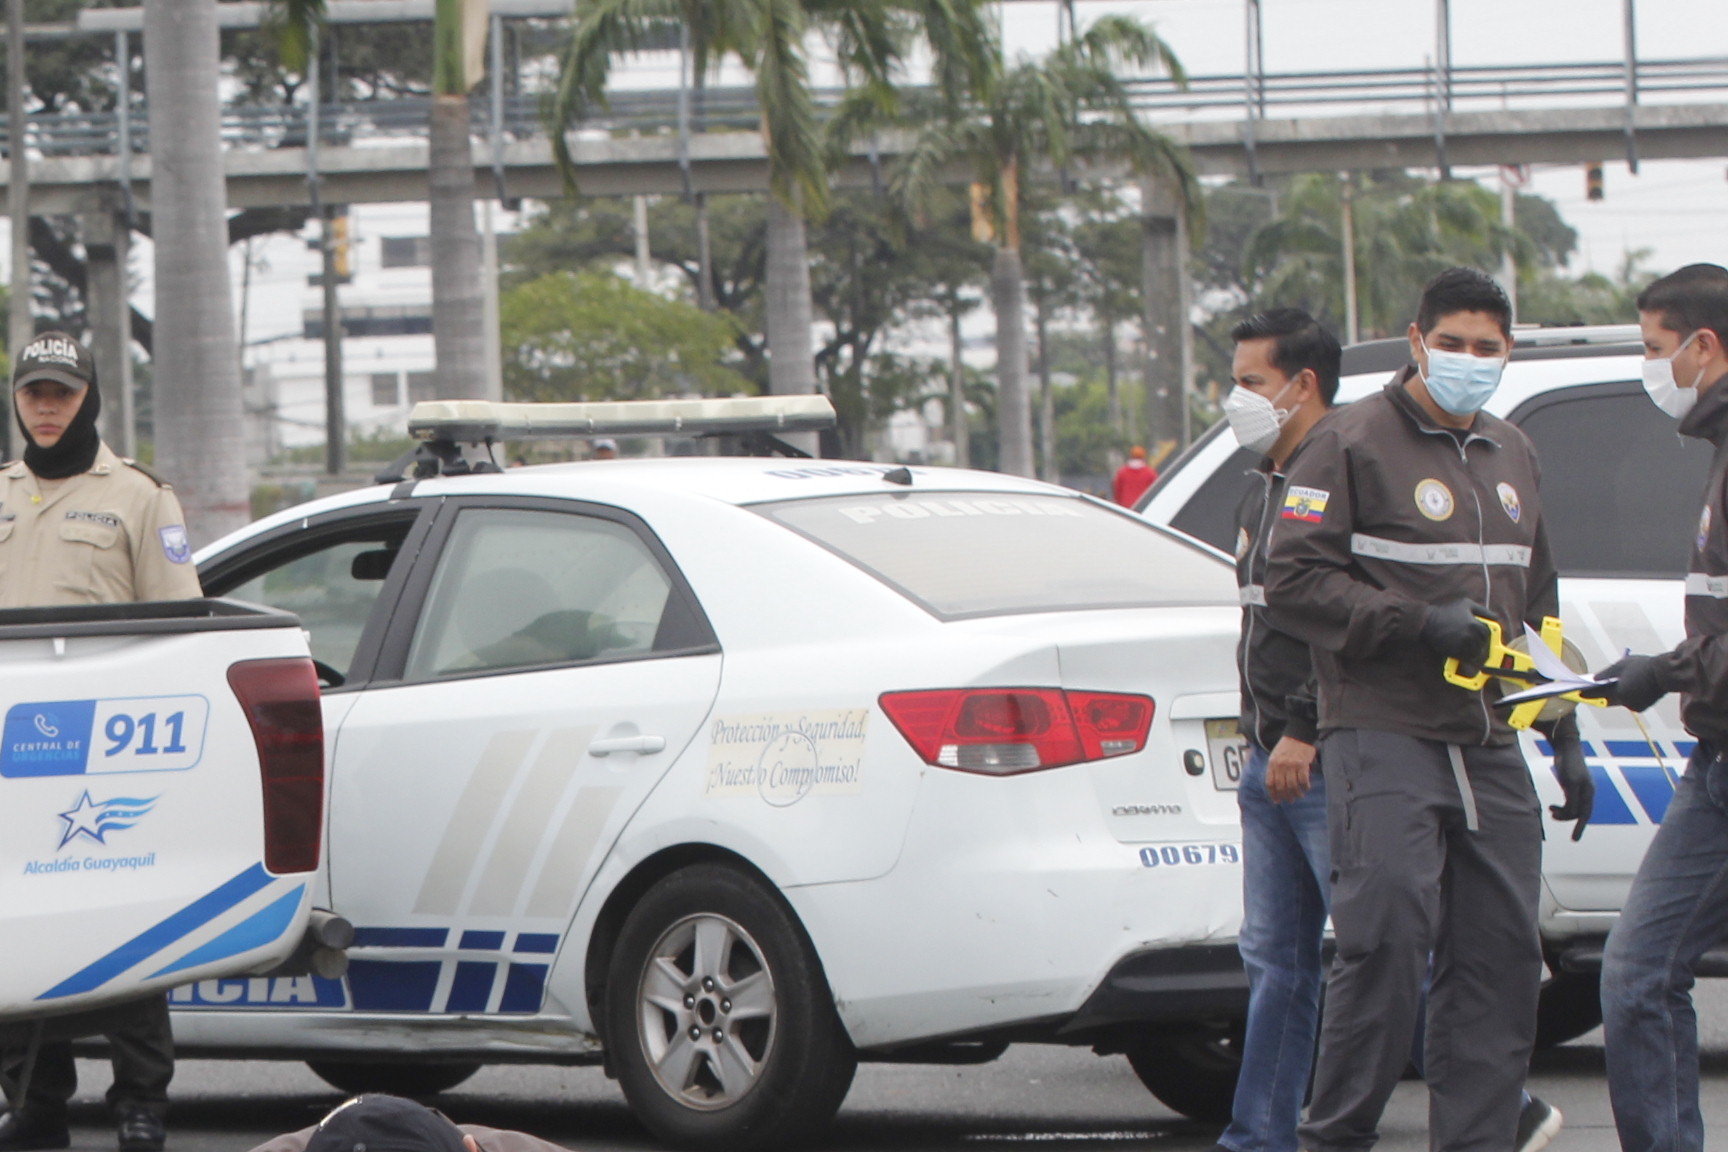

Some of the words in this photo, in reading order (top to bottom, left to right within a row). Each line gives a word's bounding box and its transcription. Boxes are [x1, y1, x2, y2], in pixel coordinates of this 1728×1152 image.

[104, 711, 187, 758] 911
[711, 716, 780, 745] Protección
[13, 742, 62, 753] CENTRAL
[66, 740, 81, 751] DE
[24, 855, 80, 875] Alcaldía
[83, 852, 156, 873] Guayaquil
[167, 974, 318, 1004] ICIA
